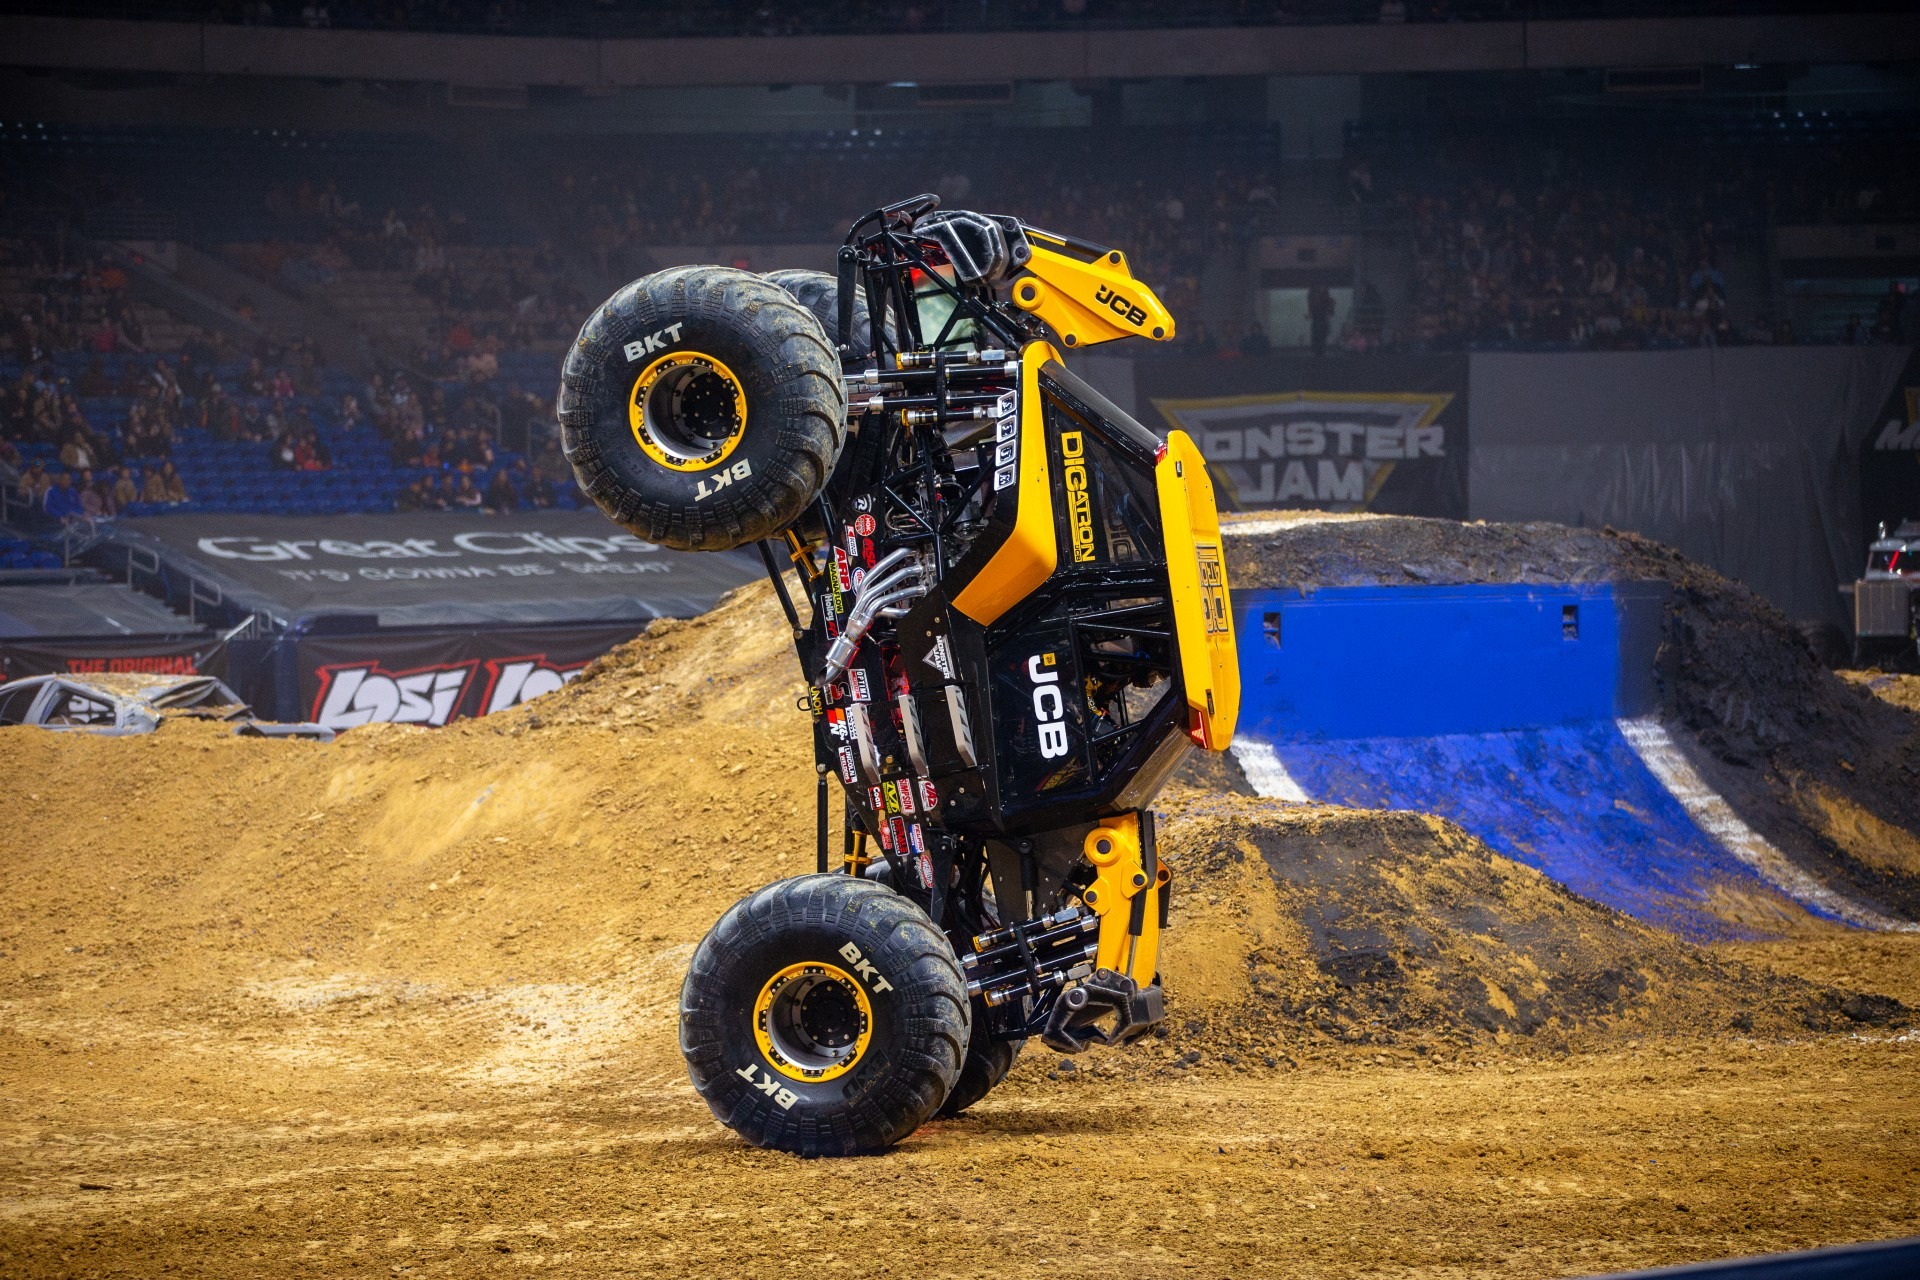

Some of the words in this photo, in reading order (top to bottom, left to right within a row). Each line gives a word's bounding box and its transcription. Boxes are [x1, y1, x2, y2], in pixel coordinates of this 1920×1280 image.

[1095, 284, 1148, 327] JCB
[623, 322, 683, 363] BKT
[1186, 421, 1445, 461] ONSTER
[694, 458, 753, 502] BKT
[1061, 431, 1096, 563] DIGATRON
[1237, 459, 1364, 502] JAM
[197, 537, 463, 562] Great
[453, 531, 660, 562] Clips
[862, 537, 877, 569] MSD
[829, 563, 843, 613] MAGNAFLOW
[835, 549, 851, 591] ARP
[824, 594, 835, 622] Holley
[67, 658, 107, 674] THE
[108, 656, 199, 675] ORIGINAL
[932, 650, 943, 670] JAM
[935, 635, 951, 679] MONSTER
[810, 687, 823, 716] UNOH
[856, 671, 869, 701] OPTIMA
[1028, 653, 1069, 759] JCB
[844, 748, 856, 777] LINCOLN
[872, 786, 881, 808] Coan
[899, 779, 913, 811] SIMPSON
[924, 781, 937, 808] JAZ
[838, 941, 894, 994] BKT
[735, 1063, 799, 1111] BKT
